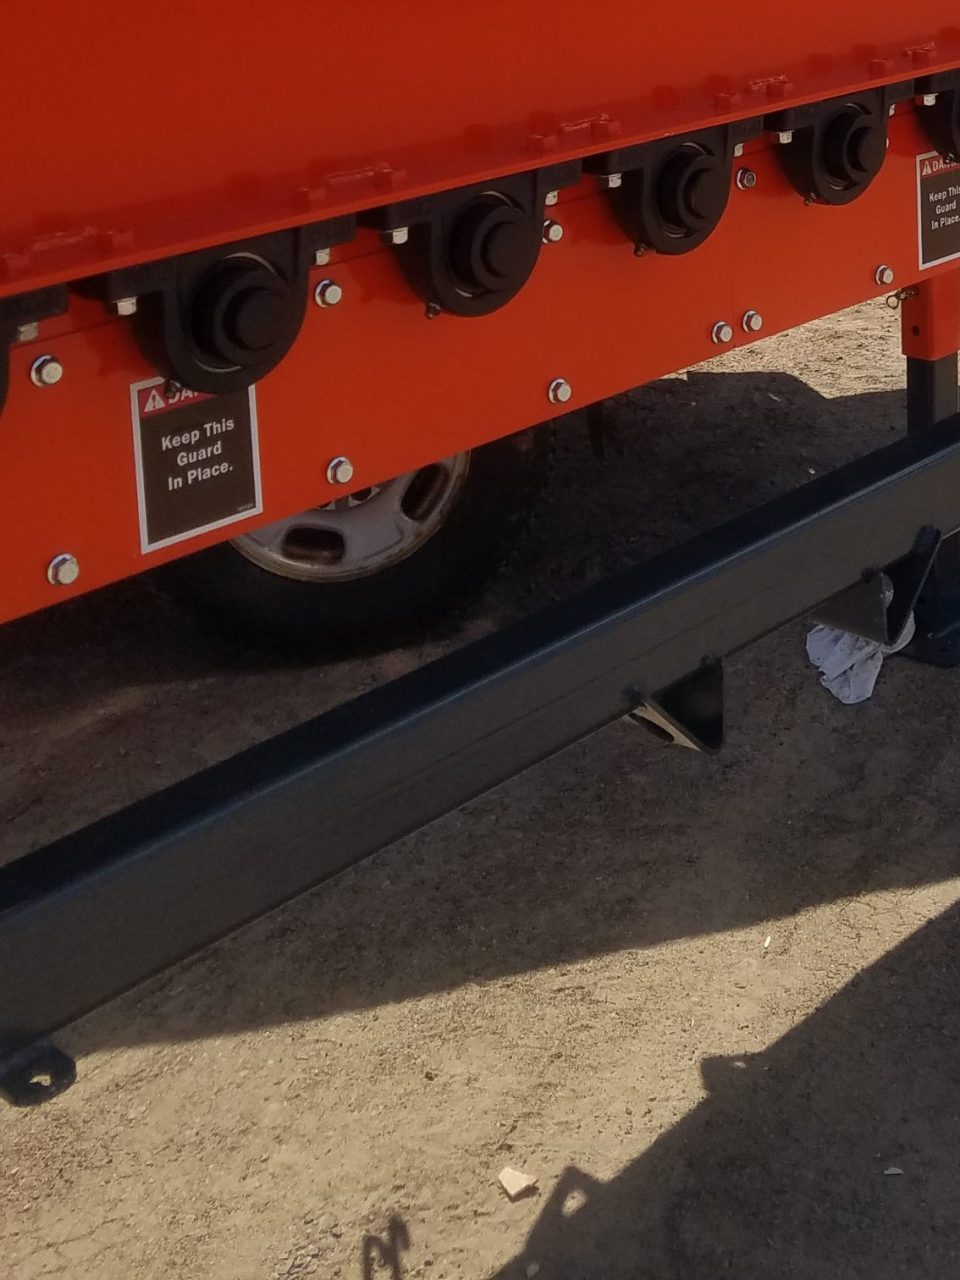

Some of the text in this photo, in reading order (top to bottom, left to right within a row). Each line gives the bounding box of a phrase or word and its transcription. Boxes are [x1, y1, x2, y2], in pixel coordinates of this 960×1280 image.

[929, 190, 947, 202] Keep
[936, 200, 957, 215] Guard
[931, 215, 960, 230] In Place.
[161, 418, 235, 451] Keep This
[177, 440, 222, 466] Guard
[168, 461, 233, 491] In Place.
